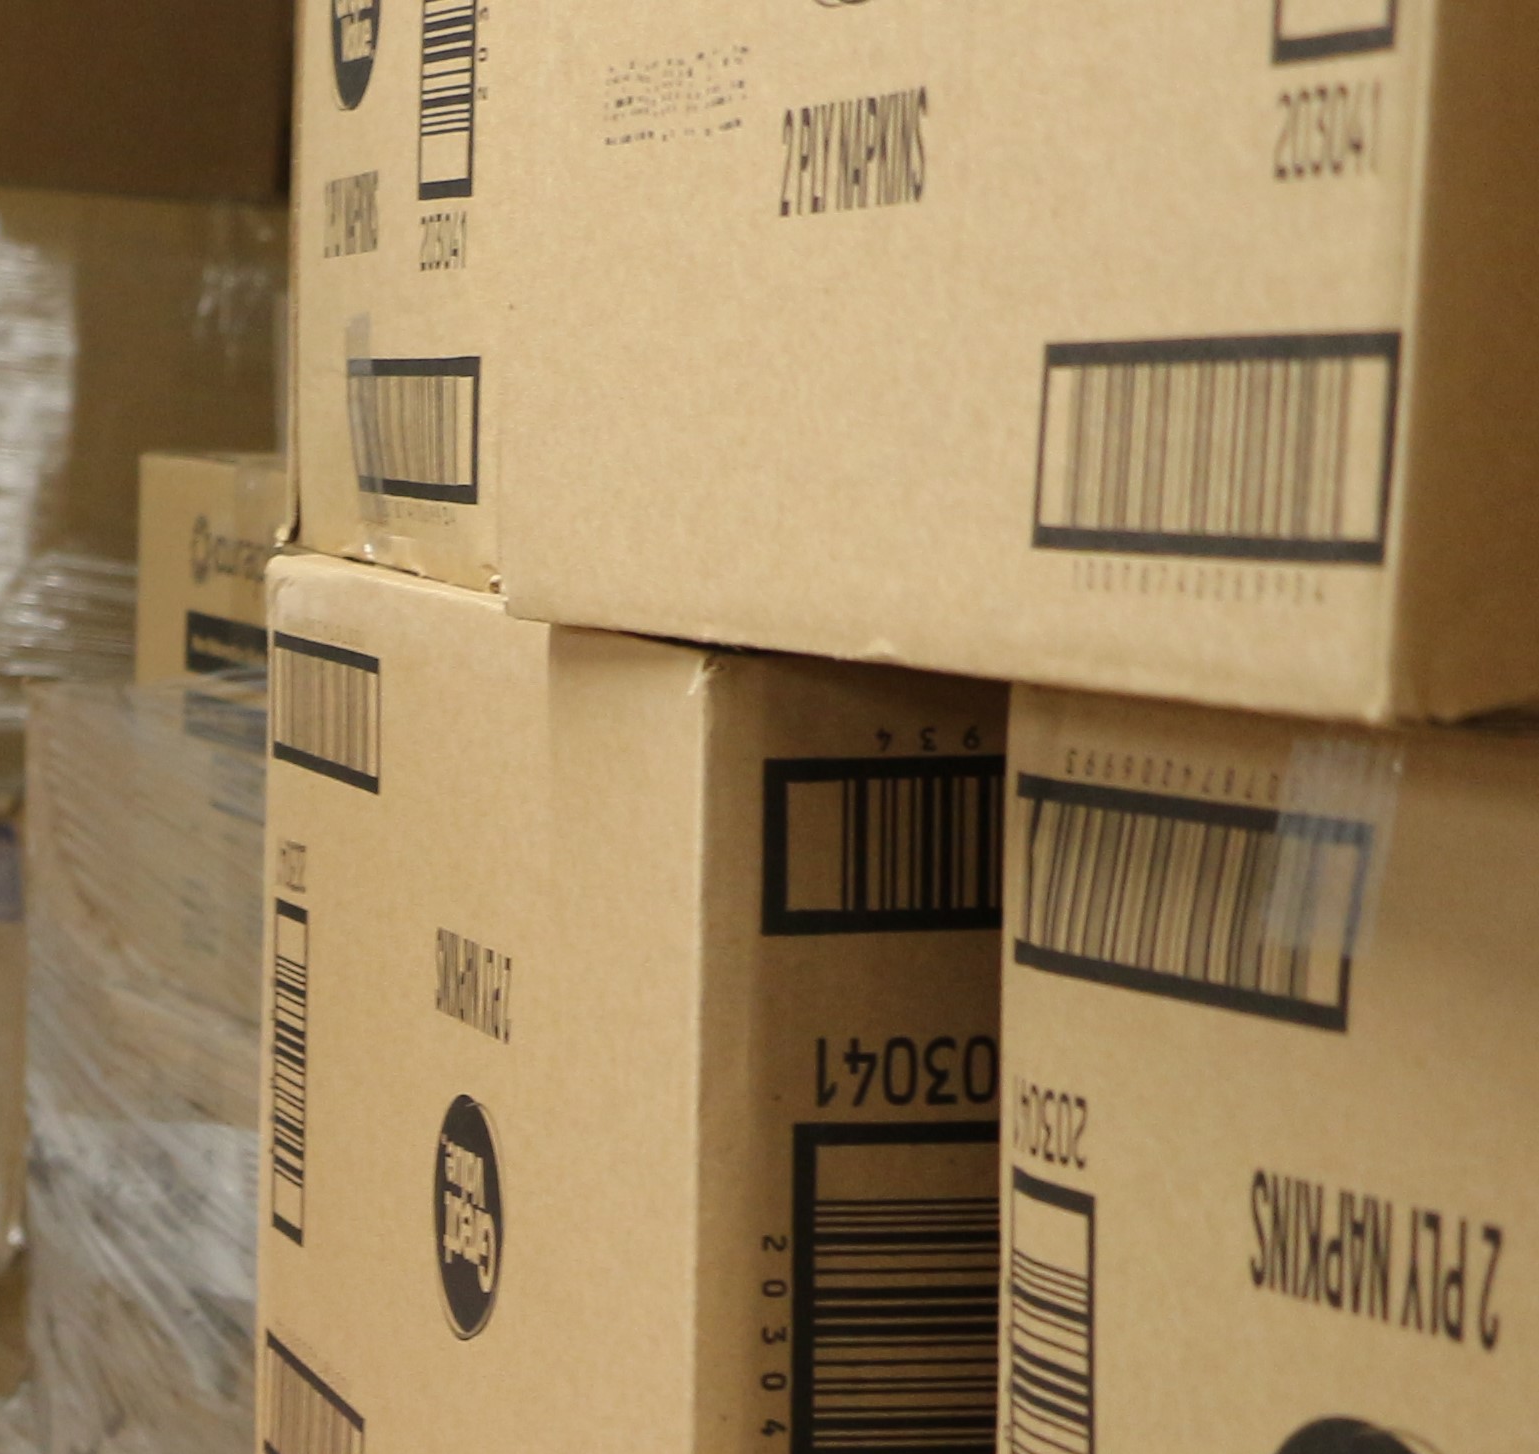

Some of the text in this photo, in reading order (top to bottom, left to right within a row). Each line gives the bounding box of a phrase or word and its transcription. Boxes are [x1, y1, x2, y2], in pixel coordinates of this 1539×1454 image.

[779, 108, 795, 217] 2
[797, 101, 836, 215] PLY
[836, 86, 928, 212] NAPKINS
[1272, 76, 1382, 181] 203041
[442, 1190, 497, 1294] Great
[1249, 1170, 1503, 1354] 2 PLY NAPKINS
